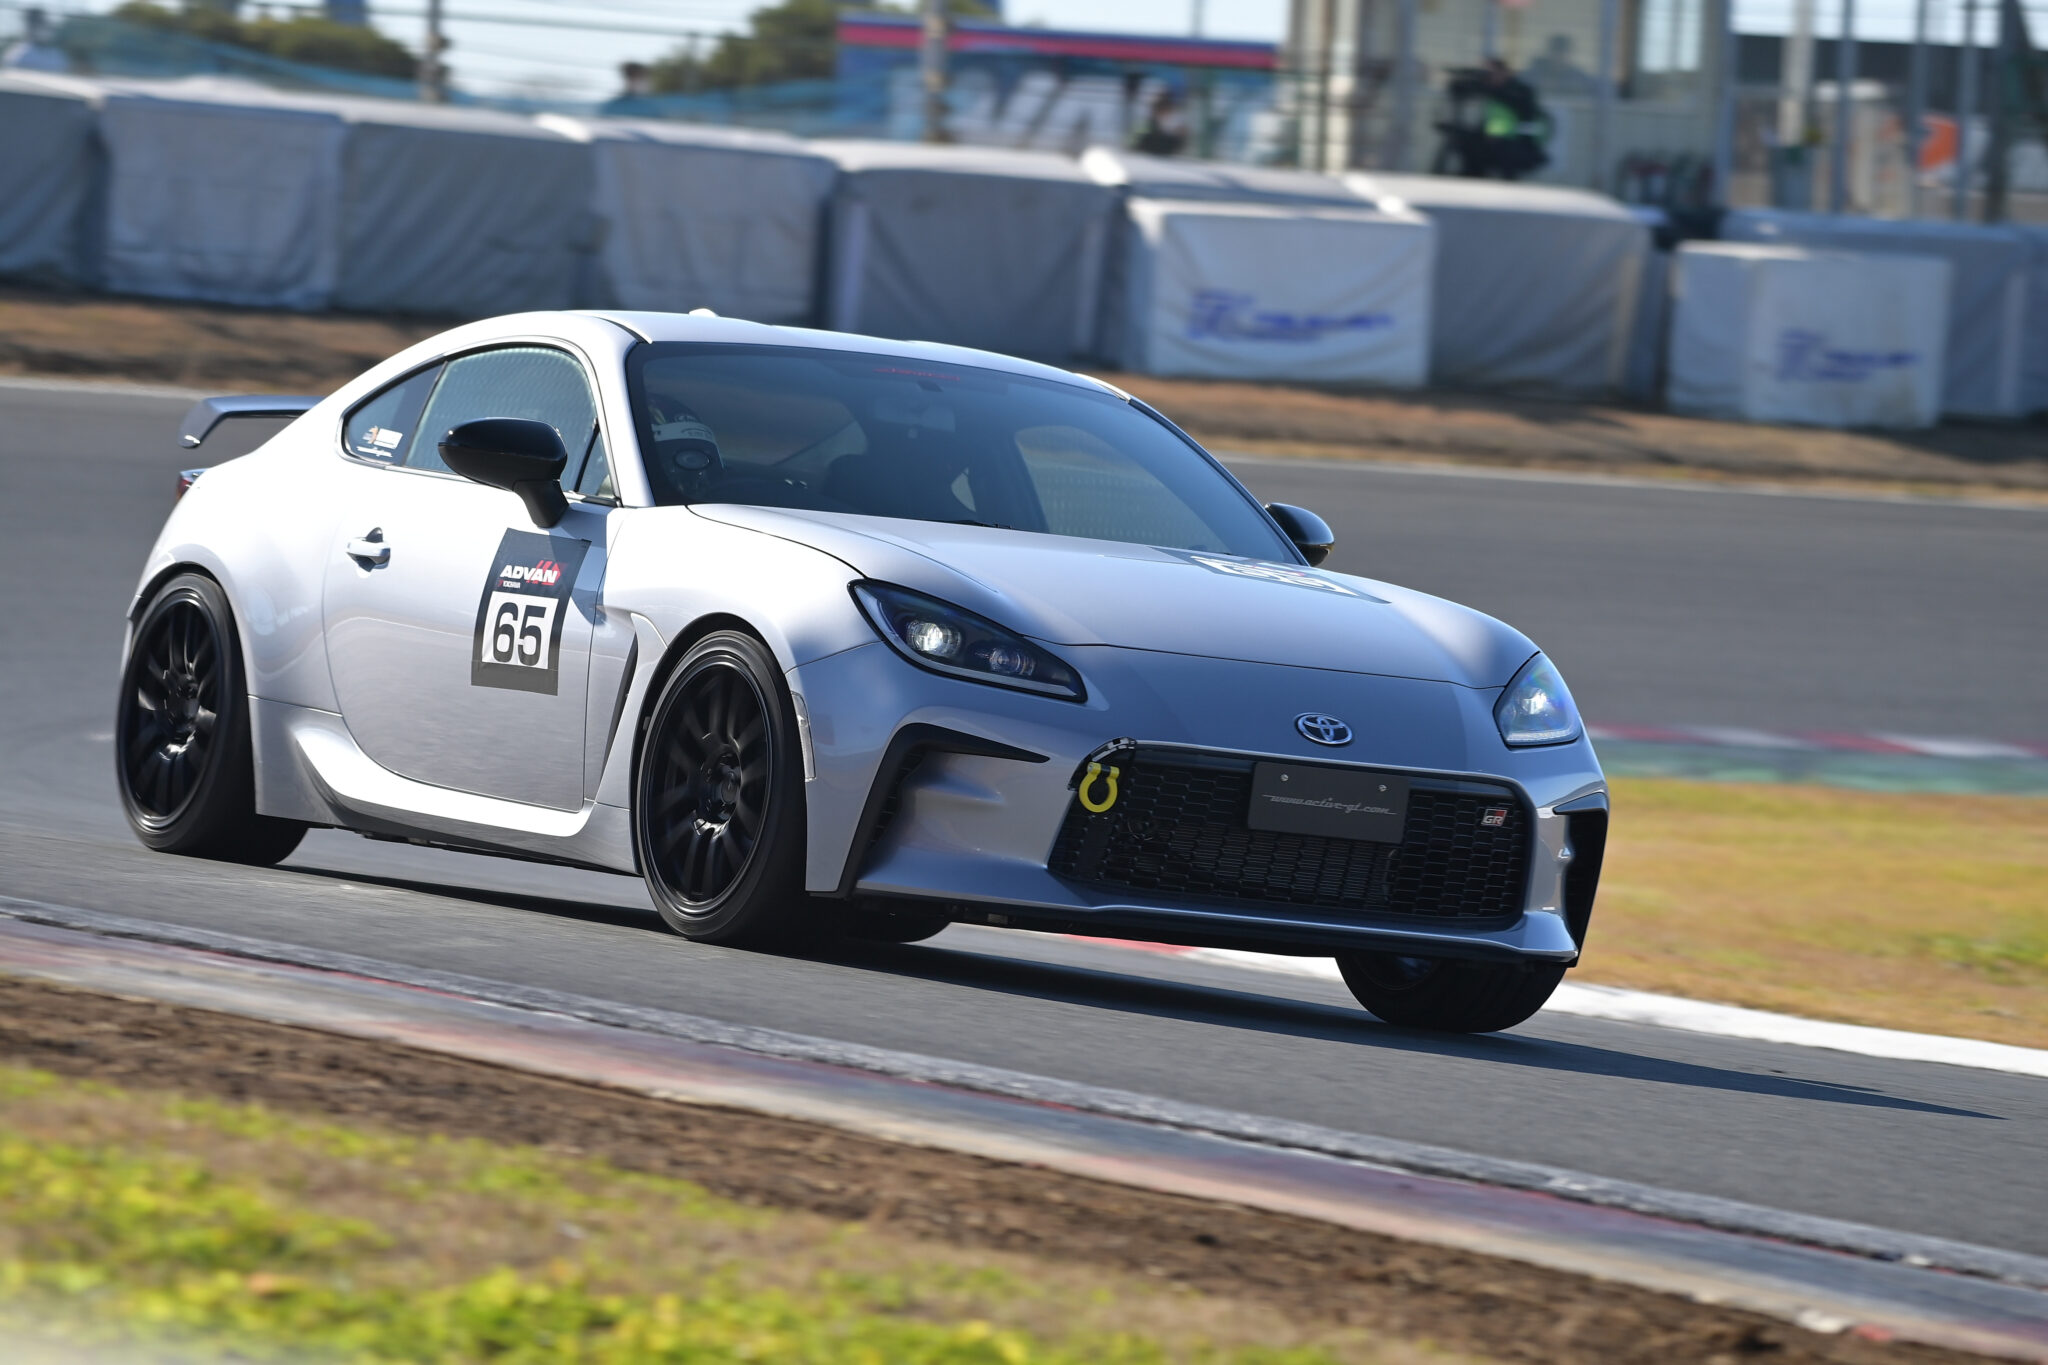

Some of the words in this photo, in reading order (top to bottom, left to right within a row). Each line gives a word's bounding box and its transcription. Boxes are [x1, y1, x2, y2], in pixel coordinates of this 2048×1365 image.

[499, 564, 558, 584] ADVAN
[493, 602, 547, 666] 65
[1482, 815, 1504, 826] GR
